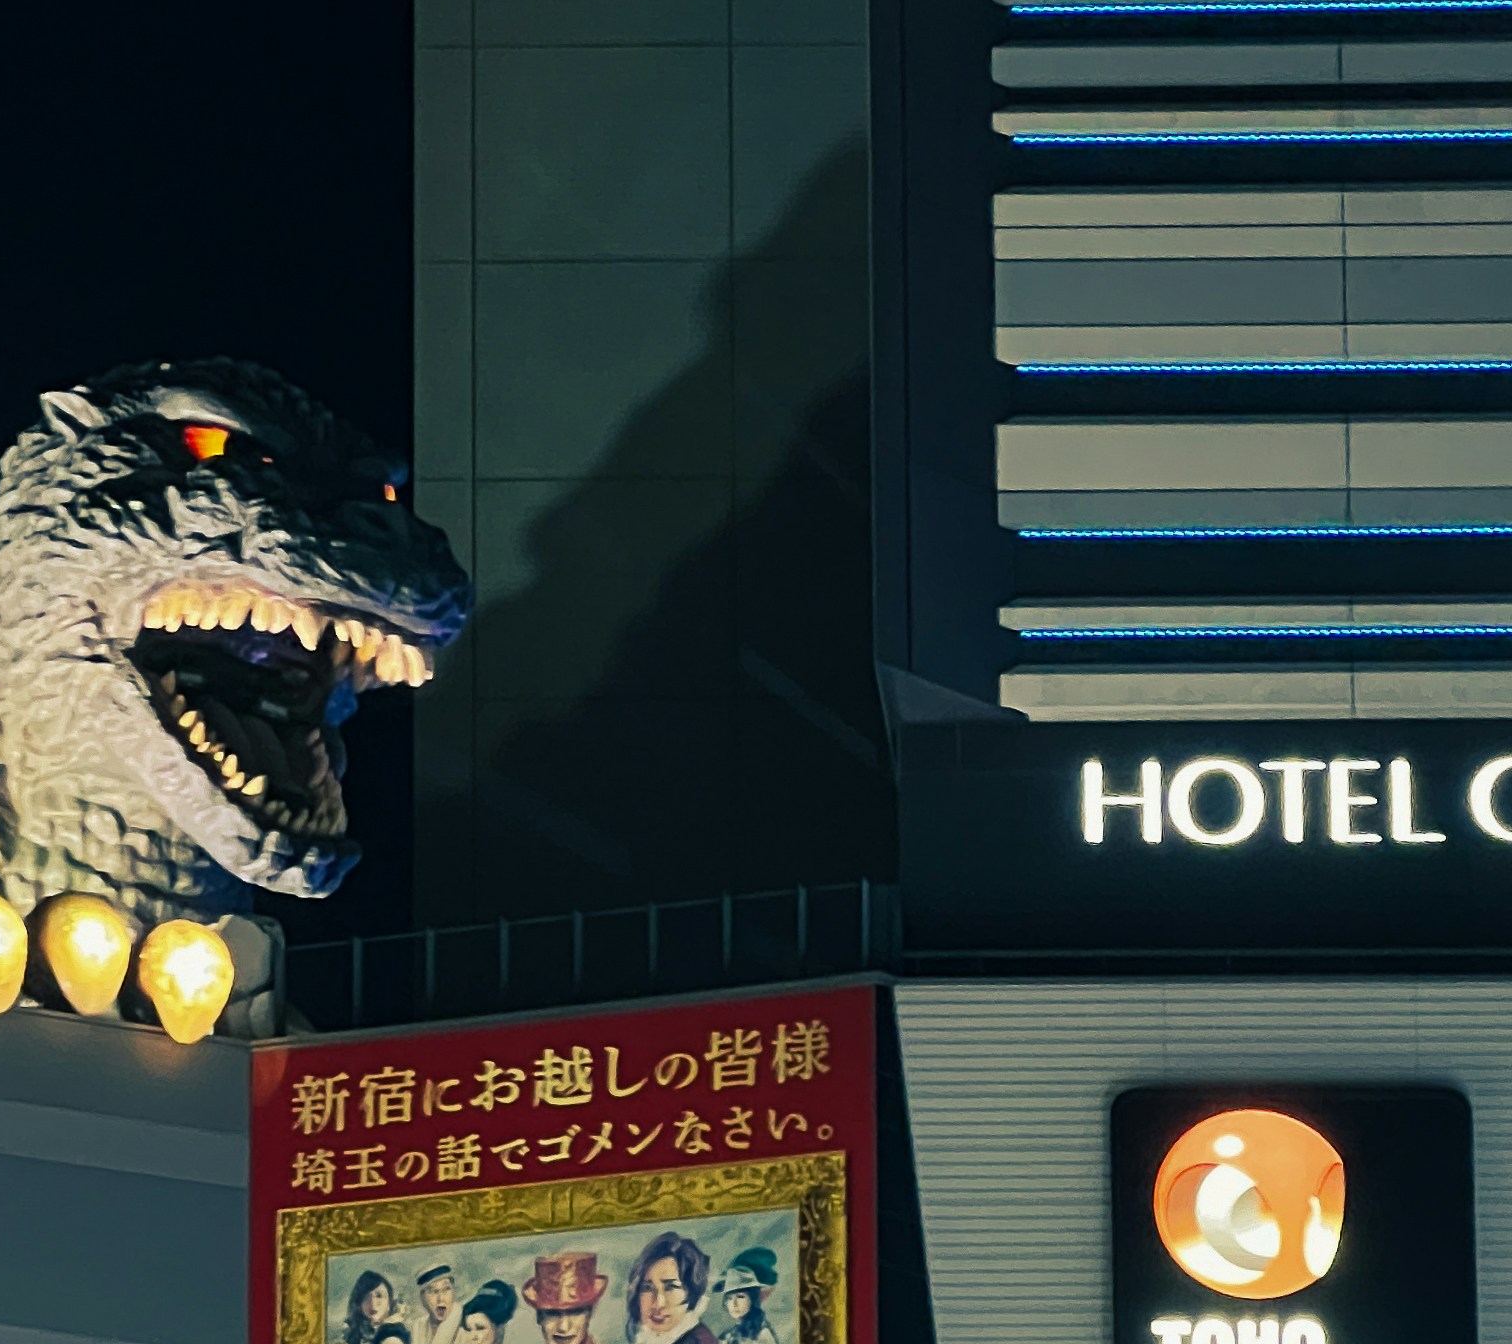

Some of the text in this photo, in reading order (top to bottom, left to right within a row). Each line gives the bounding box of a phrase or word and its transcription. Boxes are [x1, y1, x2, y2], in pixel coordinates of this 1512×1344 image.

[1082, 758, 1446, 845] HOTEL
[291, 1020, 832, 1135] 新宿にお越しの皆様
[291, 1106, 835, 1195] 埼玉の話でゴメンなさい。
